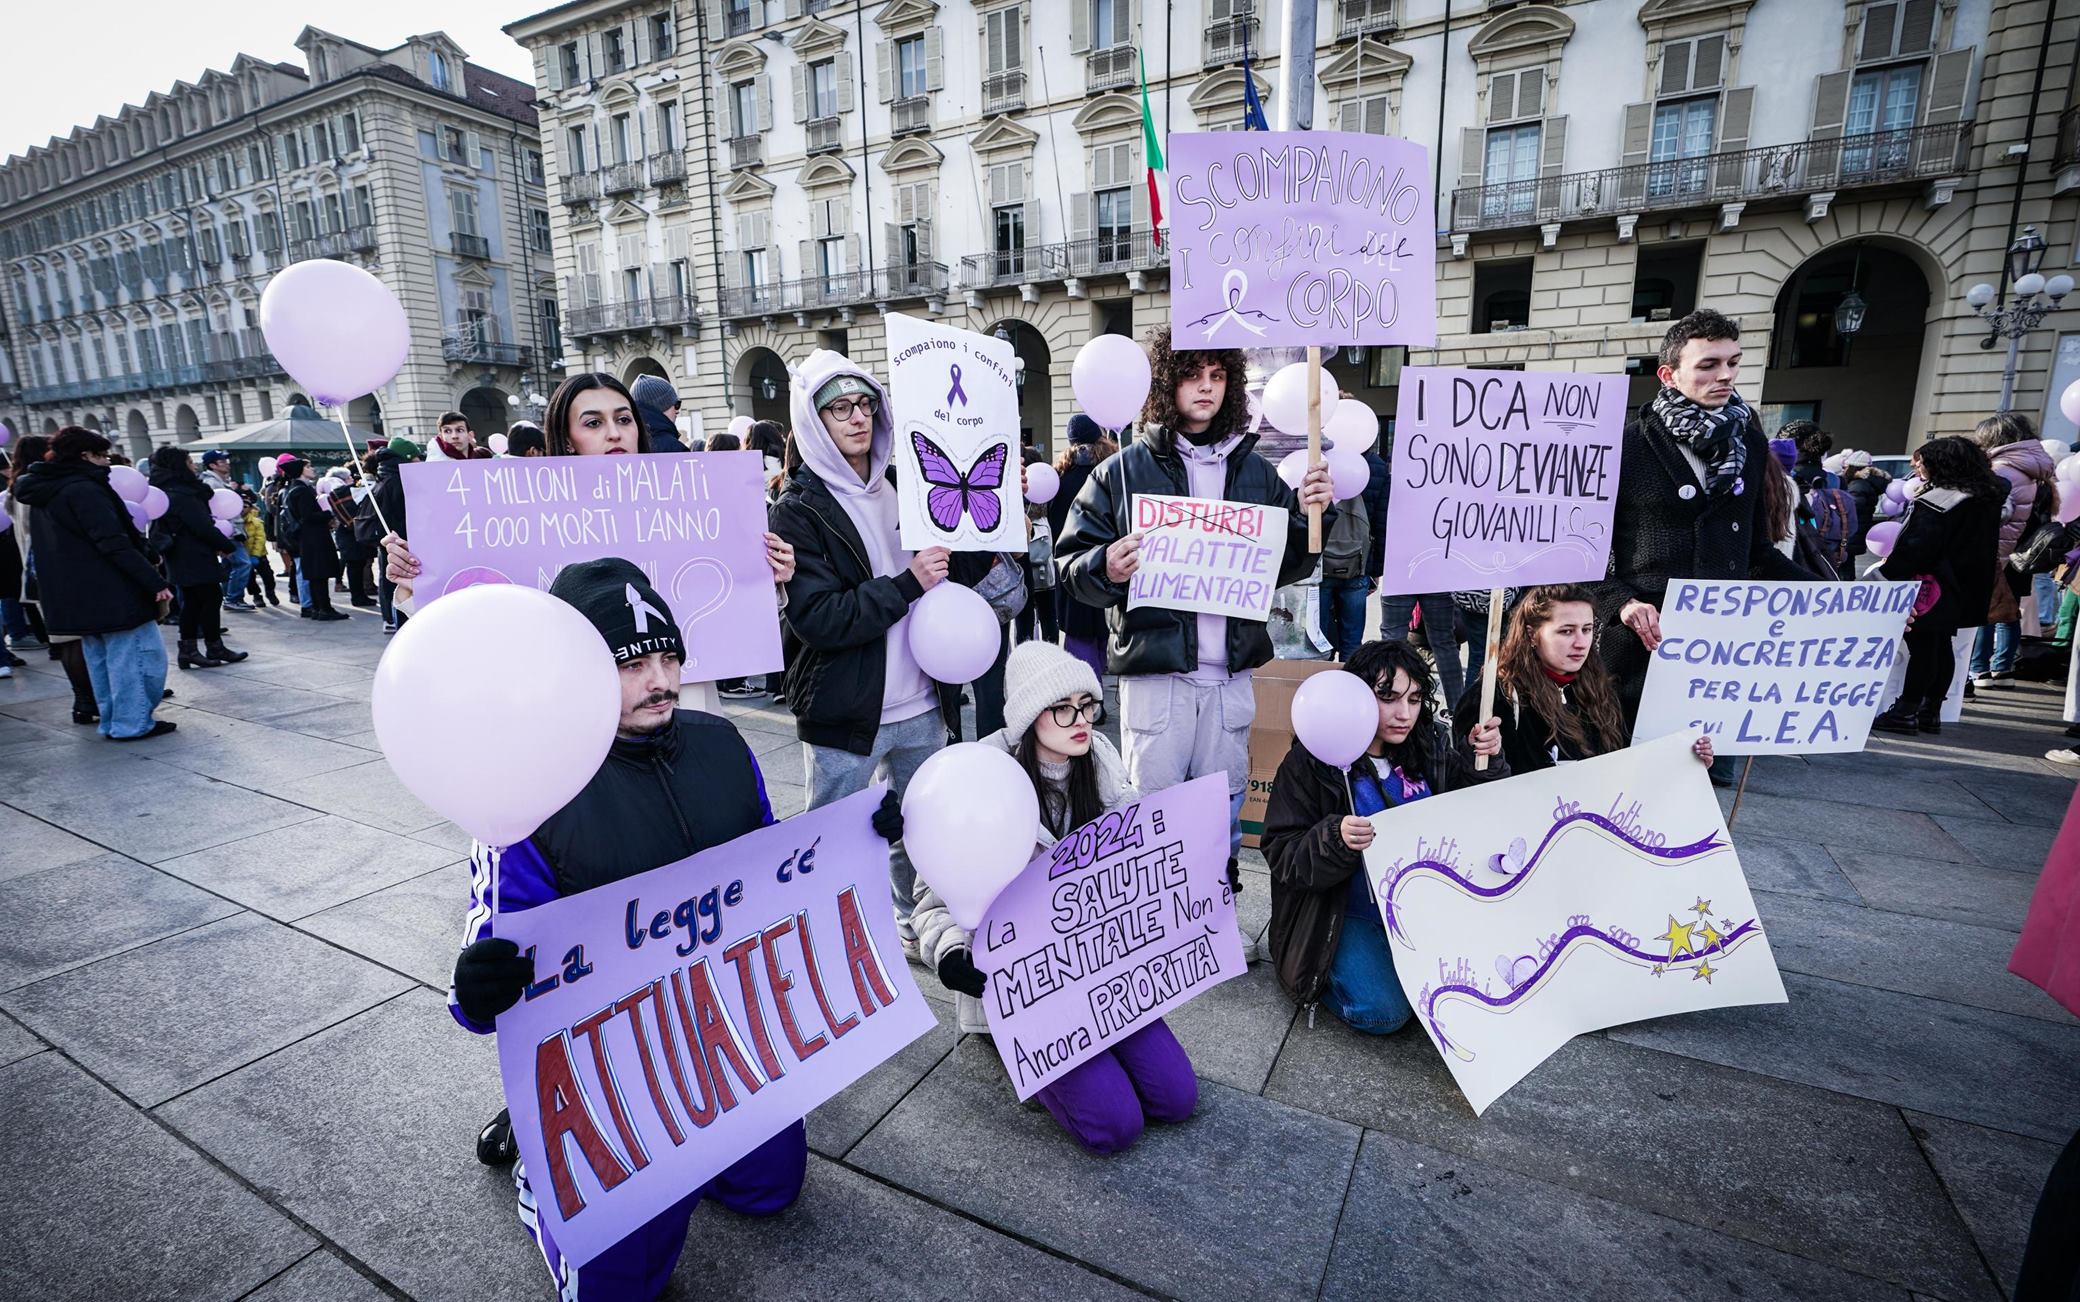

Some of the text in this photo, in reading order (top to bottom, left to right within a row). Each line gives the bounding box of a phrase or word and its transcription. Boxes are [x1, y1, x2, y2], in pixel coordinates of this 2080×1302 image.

[1176, 145, 1420, 230] SCOMPAIONO
[1178, 248, 1194, 290] I
[1287, 268, 1399, 340] CORPO
[893, 338, 1014, 388] scompaiono i confini
[933, 408, 984, 428] del corpo
[1416, 377, 1602, 431] I DCA NON
[446, 467, 471, 506] 4
[483, 465, 579, 505] MILIONI
[592, 472, 612, 499] di
[1407, 434, 1613, 501] SONO DEVIANZE
[540, 507, 619, 548] MORTI
[1139, 498, 1264, 537] DISTURBI
[1432, 497, 1558, 559] GIOVANILI
[1129, 571, 1271, 612] ALIMENTARI
[1657, 636, 1895, 670] CONCRETEZZA
[1768, 619, 1786, 637] e
[1688, 678, 1884, 707] PER LA LEGGE
[1736, 708, 1849, 744] L.E.A.
[1378, 856, 1404, 910] per
[1416, 836, 1461, 871] tutti
[1464, 863, 1474, 881] i
[1553, 795, 1582, 822] che
[986, 840, 1188, 952] La SALUTE
[523, 944, 593, 1001] La
[625, 879, 744, 957] legge
[993, 879, 1231, 1019] MENTALE Non è
[1418, 914, 1641, 1029] per tutti i che ora sono
[1013, 924, 1221, 1087] Ancora PRIORITÀ
[535, 884, 900, 1222] ATTUATELA
